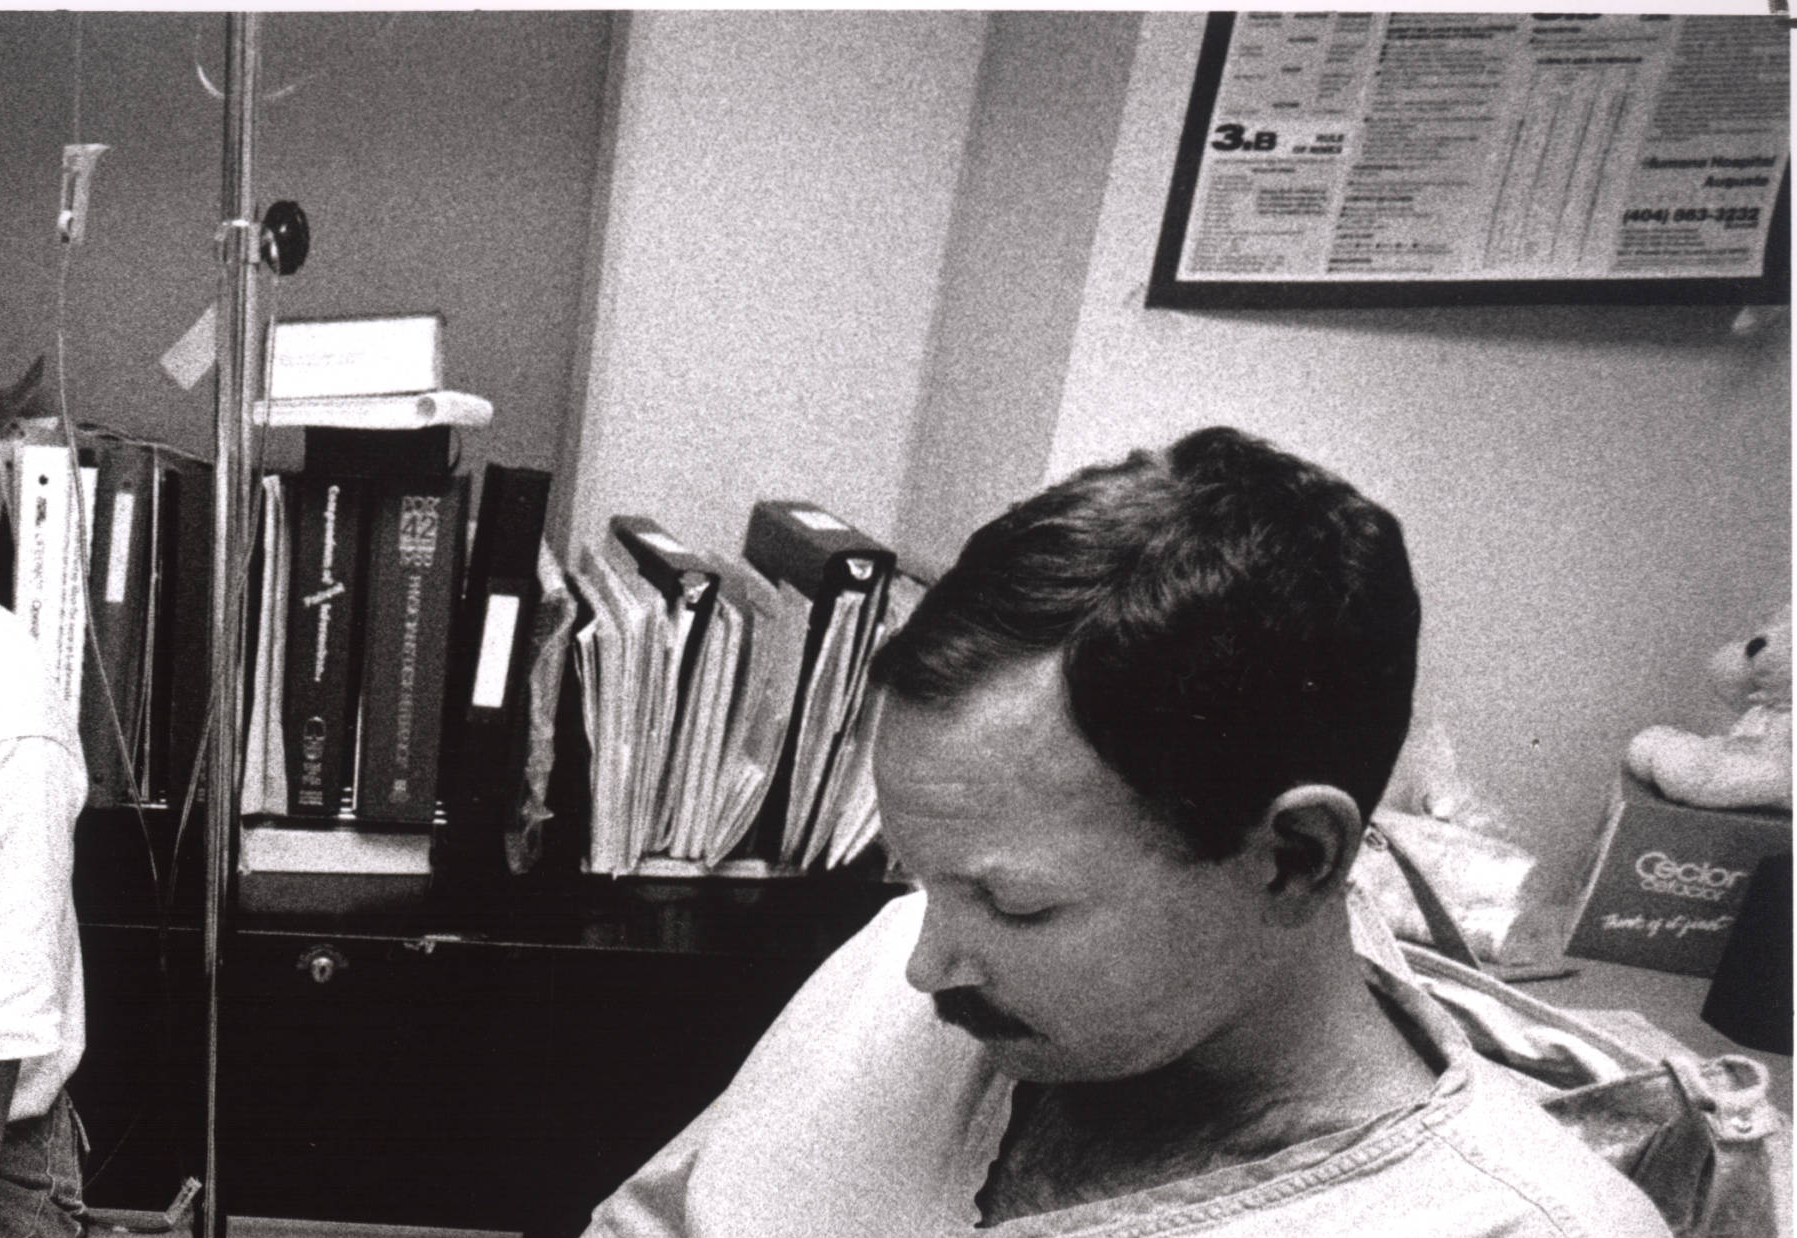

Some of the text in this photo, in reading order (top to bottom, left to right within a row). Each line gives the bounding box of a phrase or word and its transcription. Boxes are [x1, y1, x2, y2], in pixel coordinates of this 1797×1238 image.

[1212, 123, 1277, 151] 3.B
[1623, 208, 1669, 225] (404)
[402, 514, 437, 539] 42
[1635, 851, 1747, 887] Ceclor
